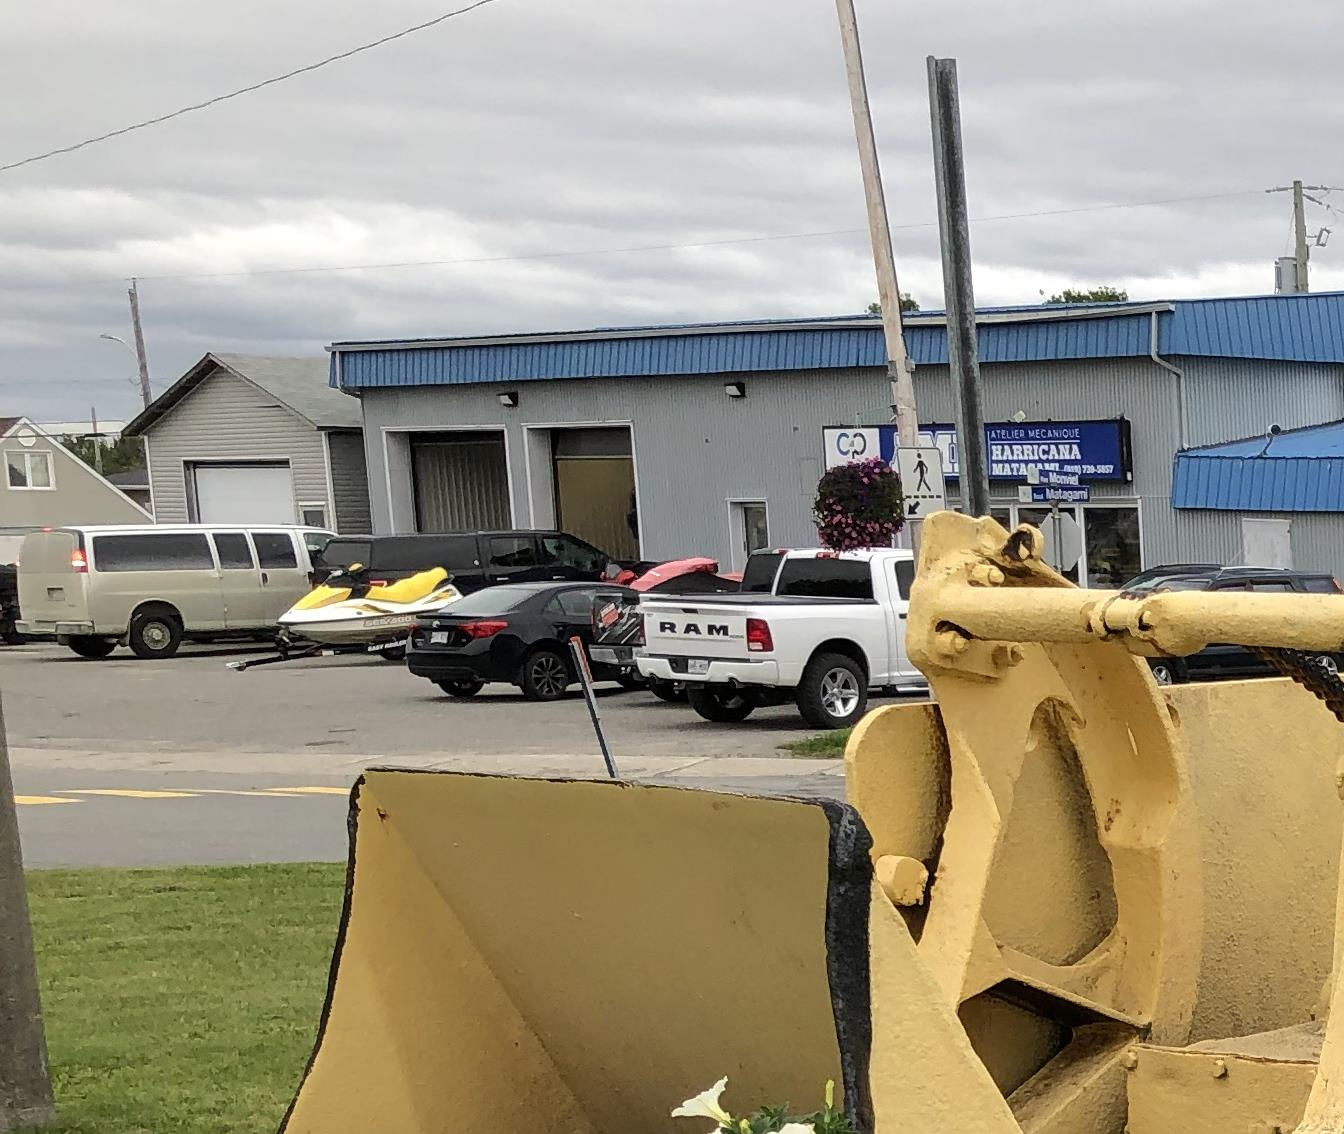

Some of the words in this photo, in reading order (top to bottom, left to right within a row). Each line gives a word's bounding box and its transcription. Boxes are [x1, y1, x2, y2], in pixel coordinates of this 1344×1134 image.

[991, 429, 1025, 439] ATELIER
[991, 444, 1081, 460] HARRICANA
[1045, 488, 1088, 501] Matagami
[659, 622, 729, 637] RAM
